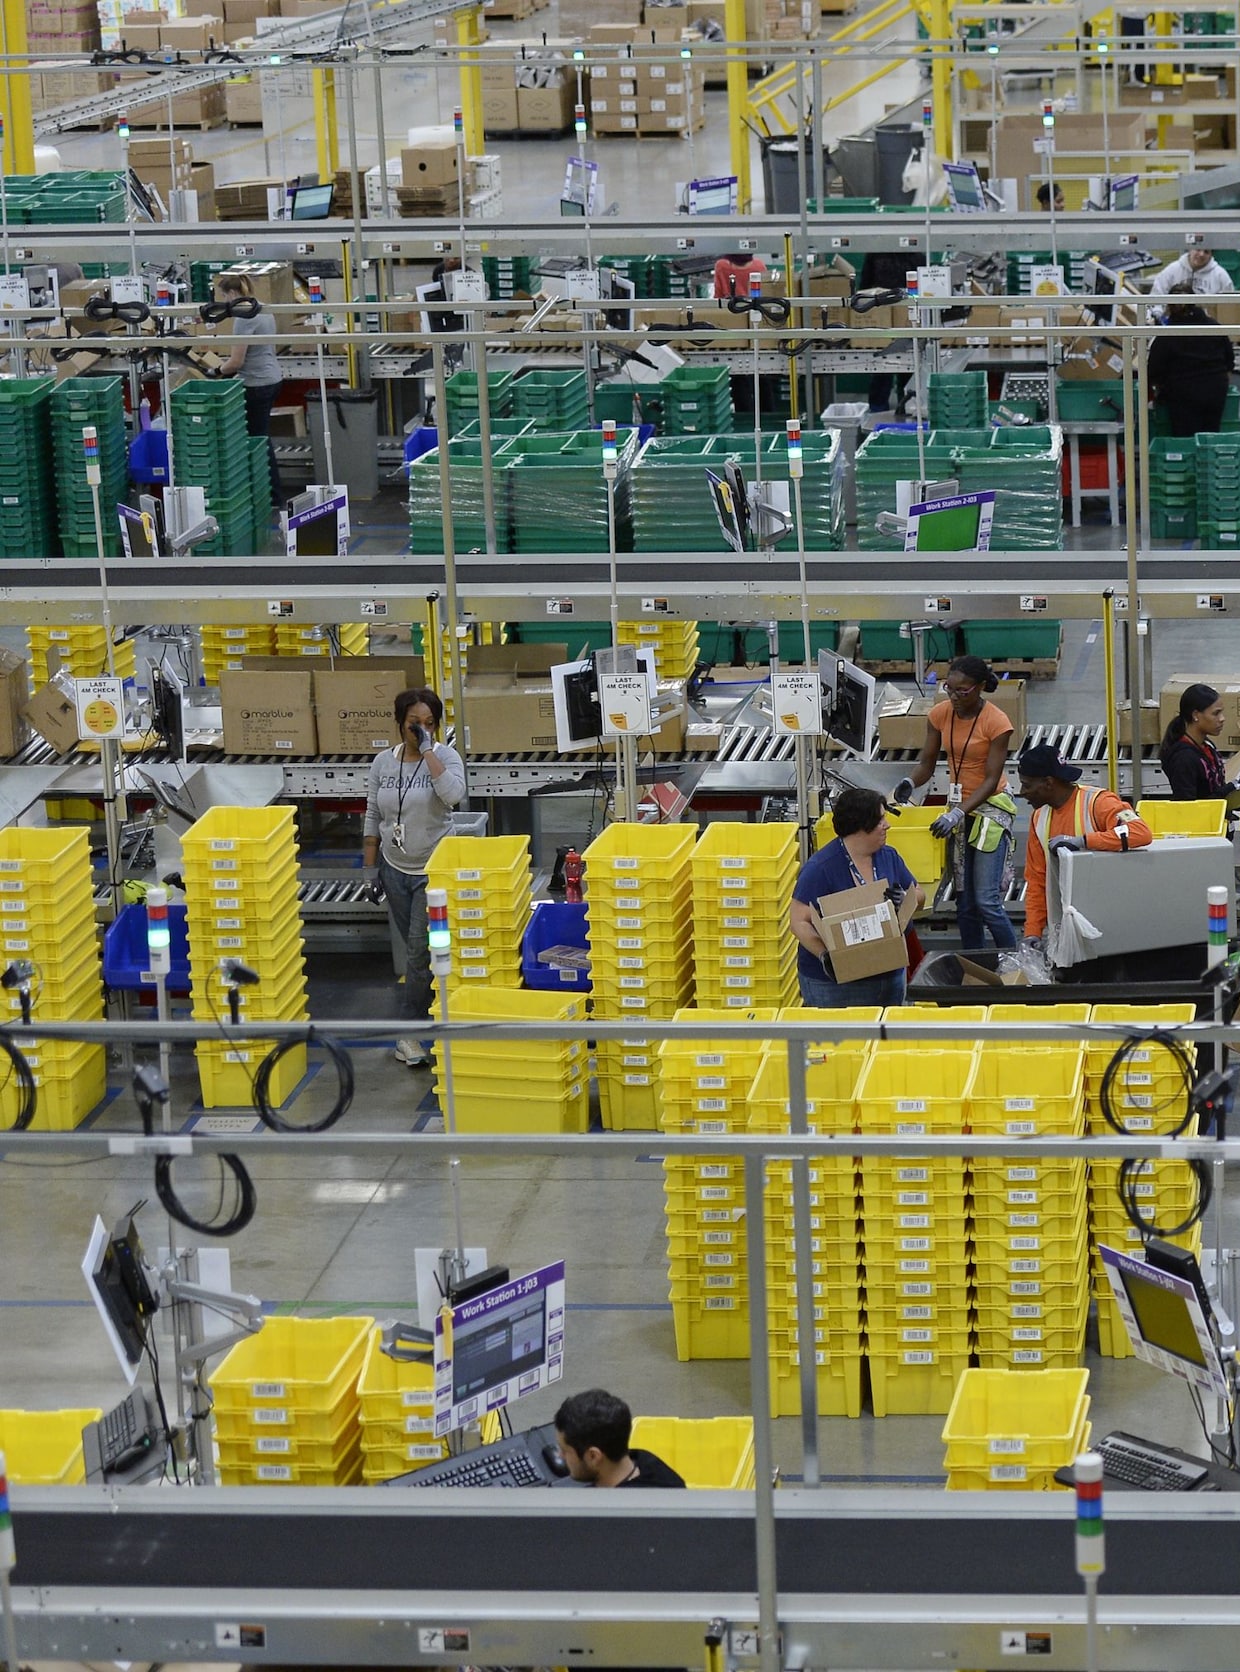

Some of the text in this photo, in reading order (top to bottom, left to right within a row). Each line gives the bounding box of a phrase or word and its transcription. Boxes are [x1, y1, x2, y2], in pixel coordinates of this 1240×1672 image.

[925, 502, 941, 511] Work
[941, 499, 962, 508] Station
[251, 709, 294, 718] marblue
[348, 709, 393, 718] marblue
[379, 774, 434, 790] EBONAIR
[461, 1276, 539, 1320] Work Station 1-j03
